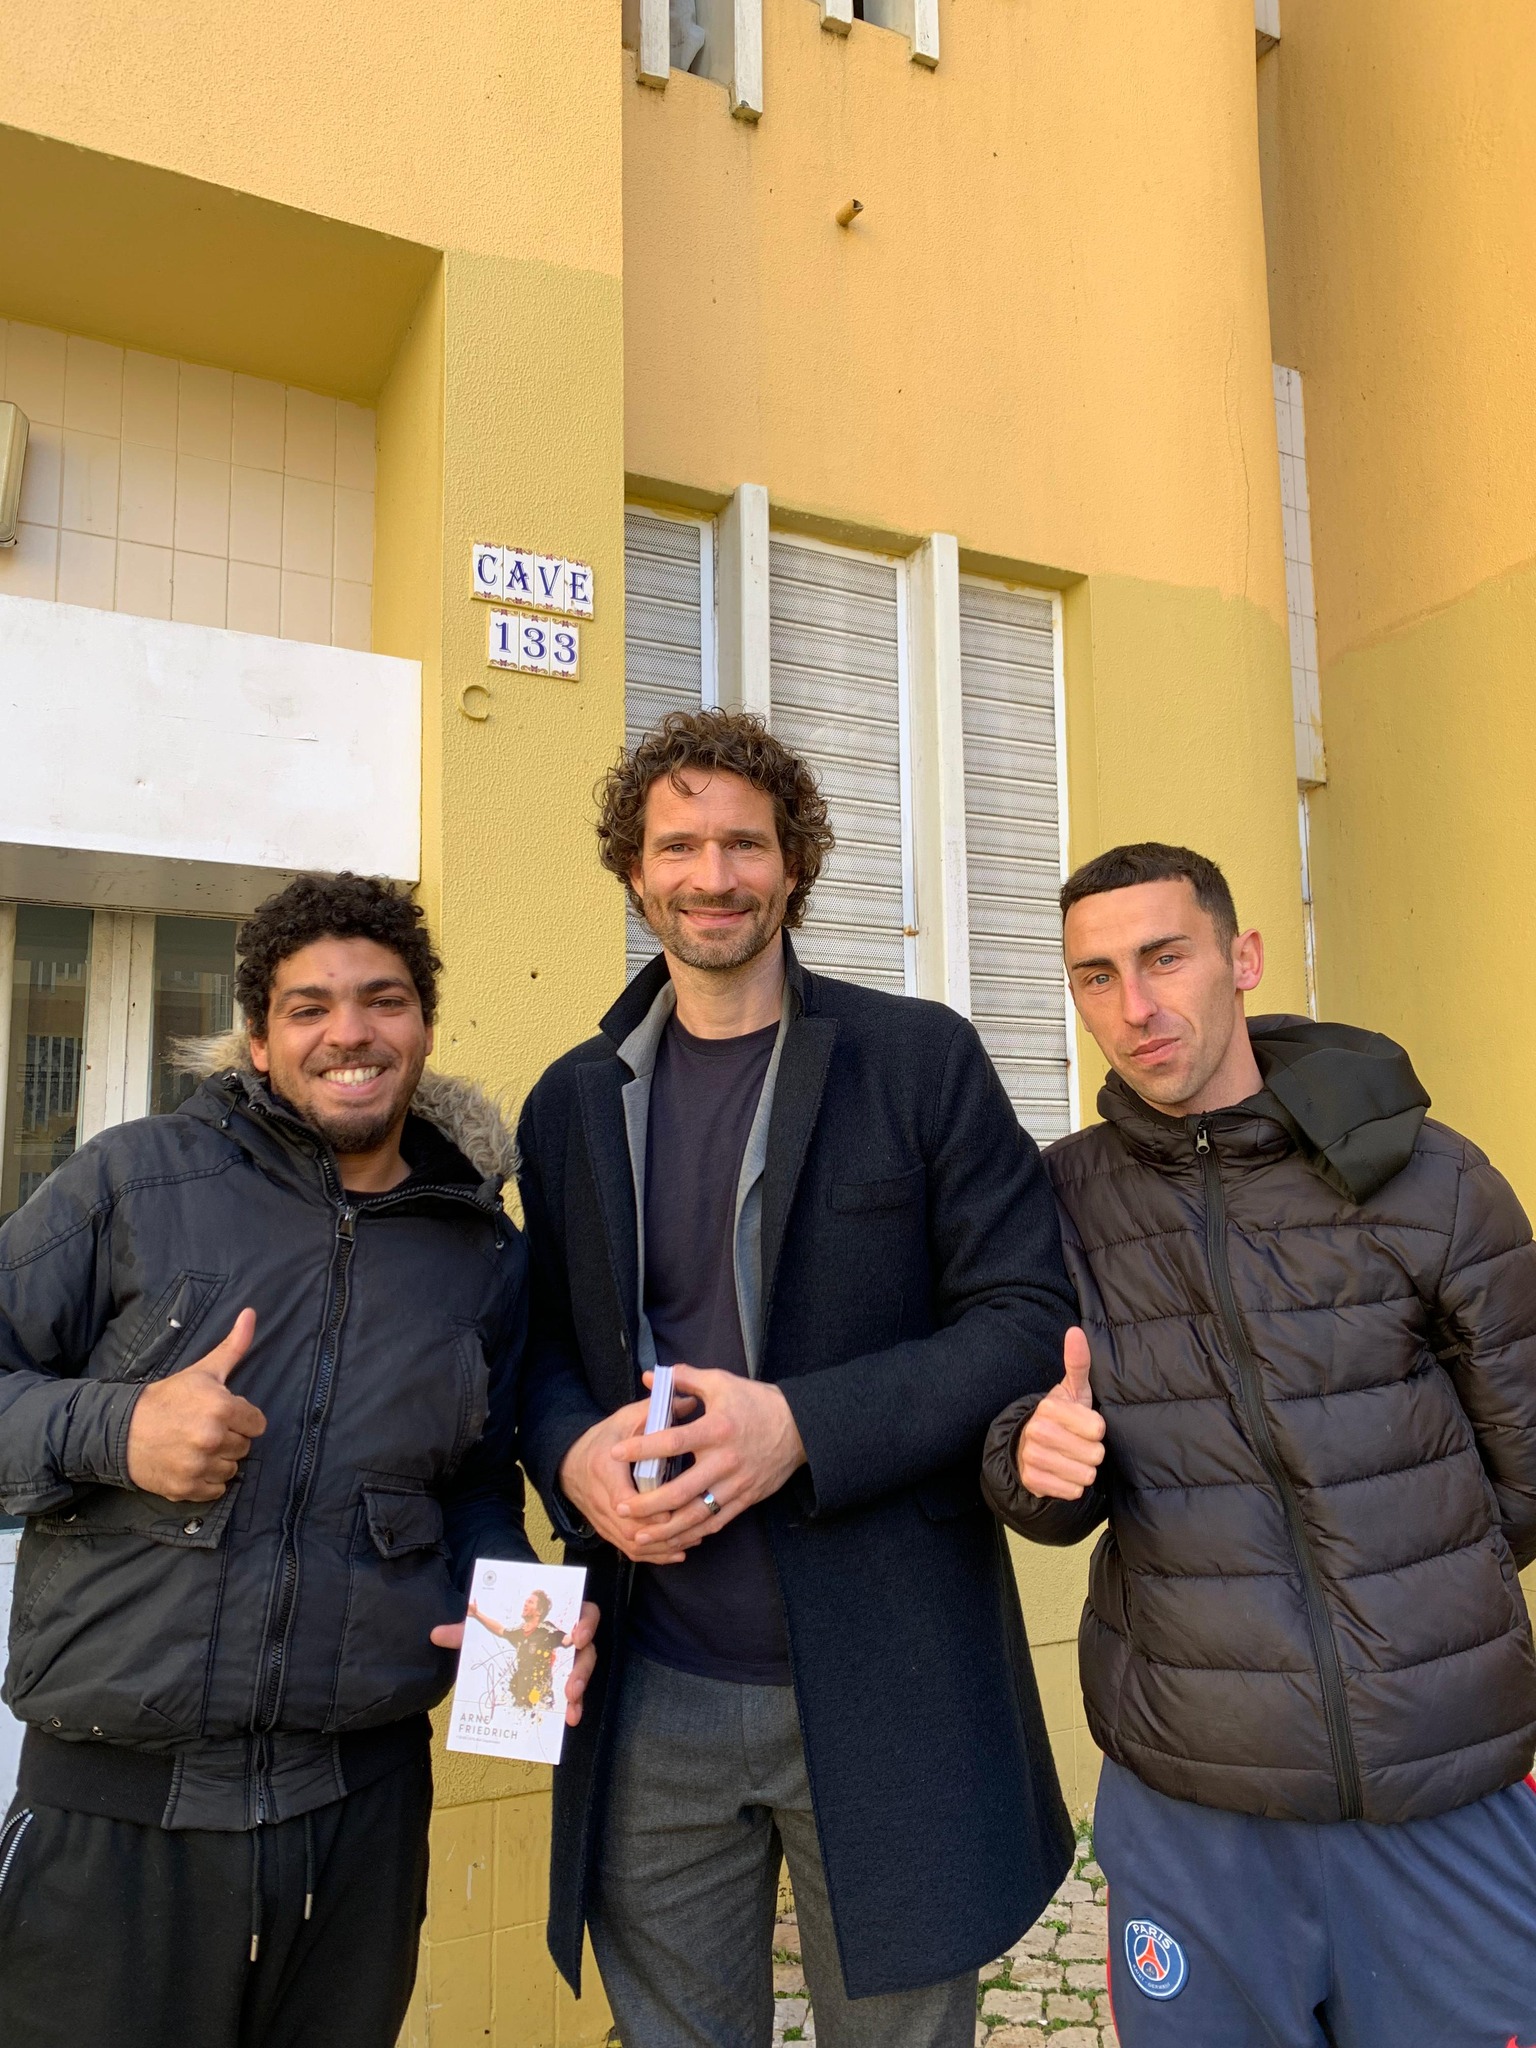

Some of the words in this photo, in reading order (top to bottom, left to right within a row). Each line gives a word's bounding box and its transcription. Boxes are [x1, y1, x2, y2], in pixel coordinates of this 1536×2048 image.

[477, 554, 590, 604] CAVE
[496, 622, 577, 665] 133
[458, 1723, 518, 1740] FRIEDRICH
[460, 1712, 491, 1725] ARNE
[1132, 1923, 1173, 1950] PARIS
